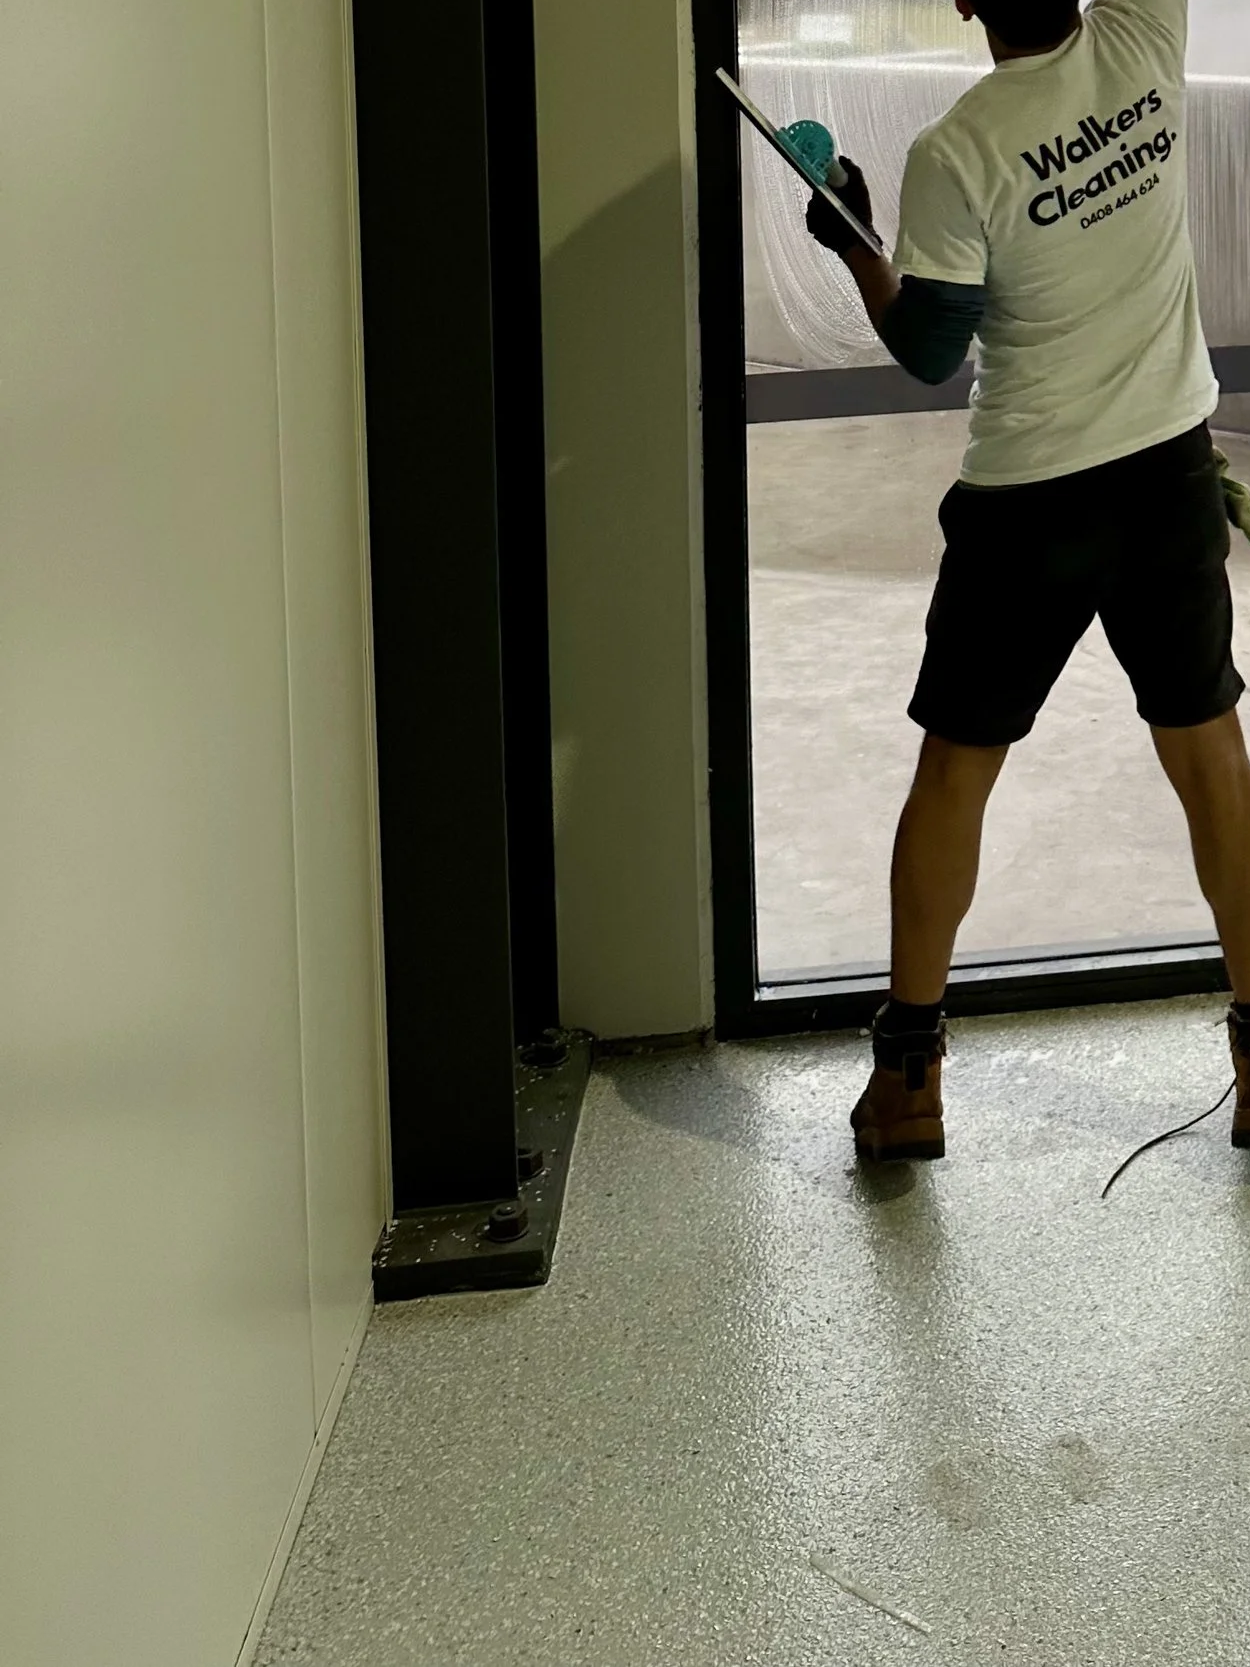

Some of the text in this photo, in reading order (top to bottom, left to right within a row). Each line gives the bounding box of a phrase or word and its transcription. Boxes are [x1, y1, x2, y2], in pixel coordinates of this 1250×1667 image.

[1020, 88, 1162, 181] Walkers
[1028, 127, 1177, 226] Cleaning.
[1080, 173, 1160, 229] 0408 464 624
